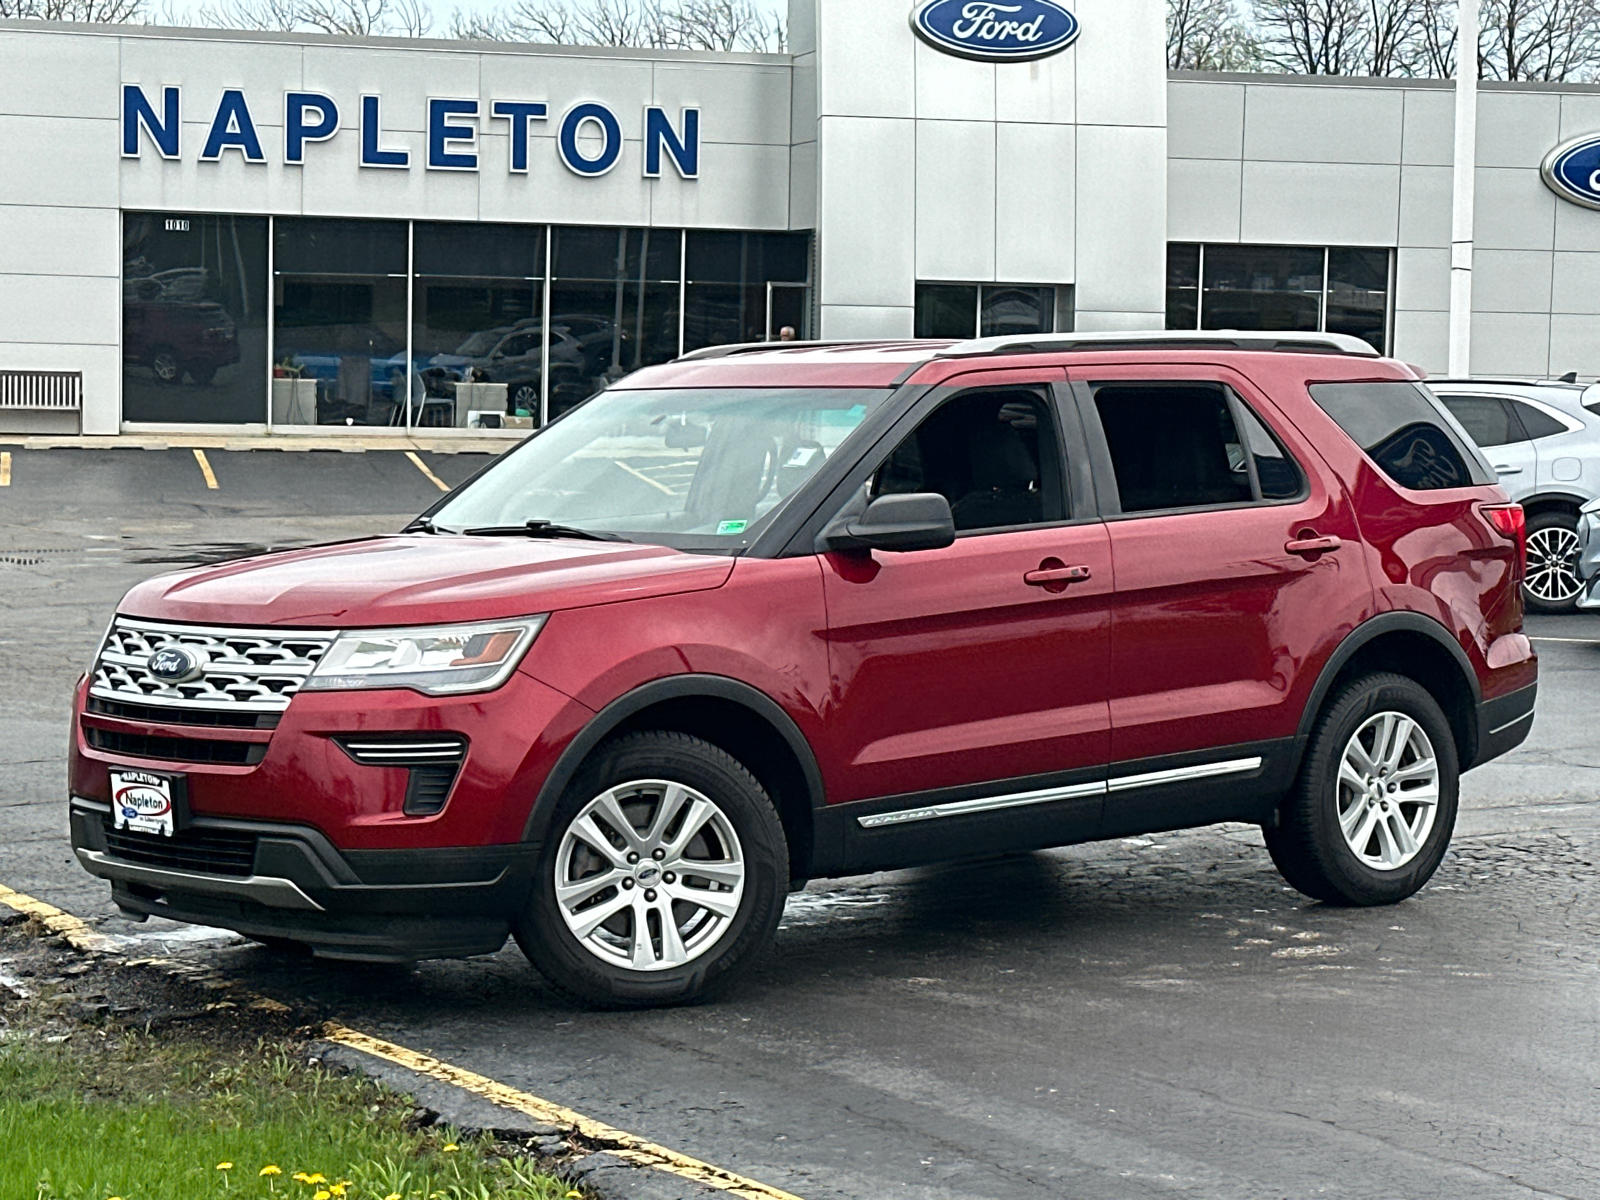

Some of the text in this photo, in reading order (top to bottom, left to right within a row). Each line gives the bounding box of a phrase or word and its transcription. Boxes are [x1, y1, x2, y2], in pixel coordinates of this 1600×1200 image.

[953, 2, 1045, 42] Ford
[120, 84, 700, 179] NAPLETON
[165, 219, 190, 231] 1010
[152, 652, 181, 671] Ford
[125, 791, 163, 810] Napleton
